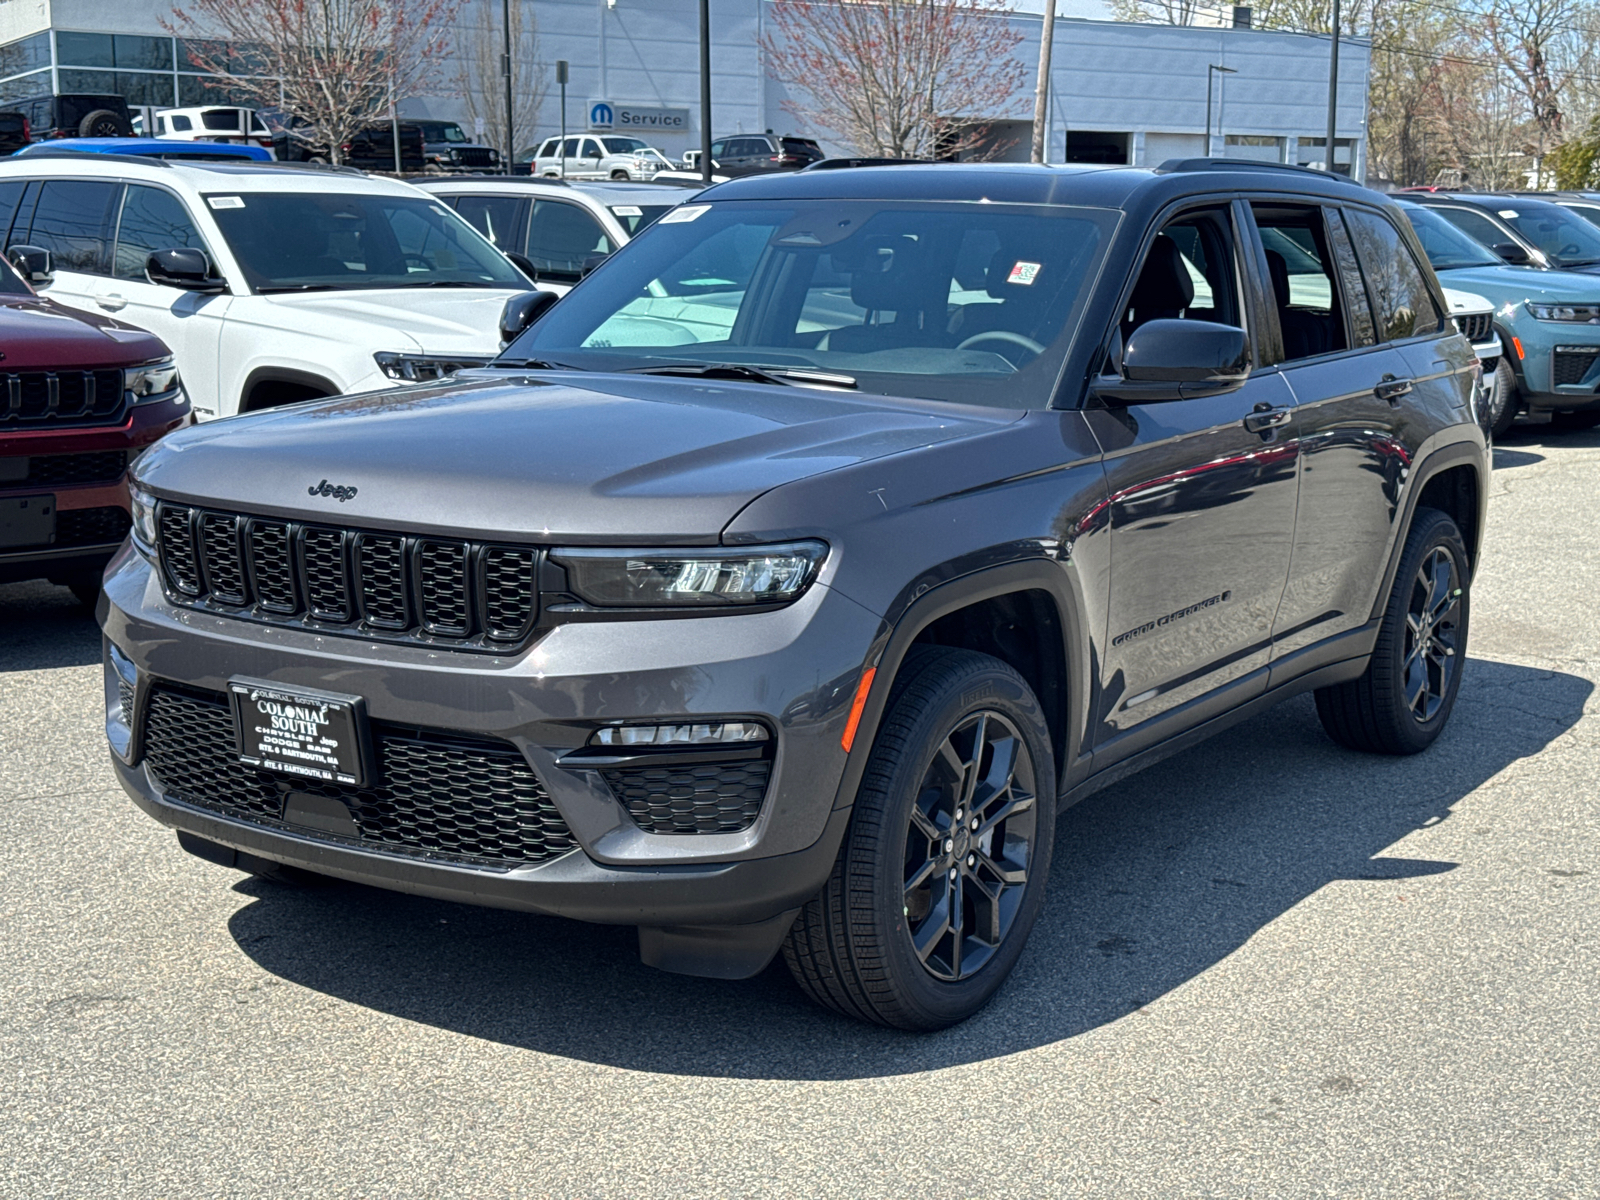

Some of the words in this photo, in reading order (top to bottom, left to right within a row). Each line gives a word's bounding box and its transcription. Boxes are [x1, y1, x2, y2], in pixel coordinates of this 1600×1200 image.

[620, 111, 682, 126] Service
[307, 479, 358, 503] Jeep
[1112, 621, 1155, 646] GRAND
[257, 700, 329, 725] COLONIAL
[255, 726, 313, 742] CHRYSLER
[271, 715, 318, 736] SOUTH
[263, 736, 300, 749] DODGE
[320, 736, 338, 748] Jeep
